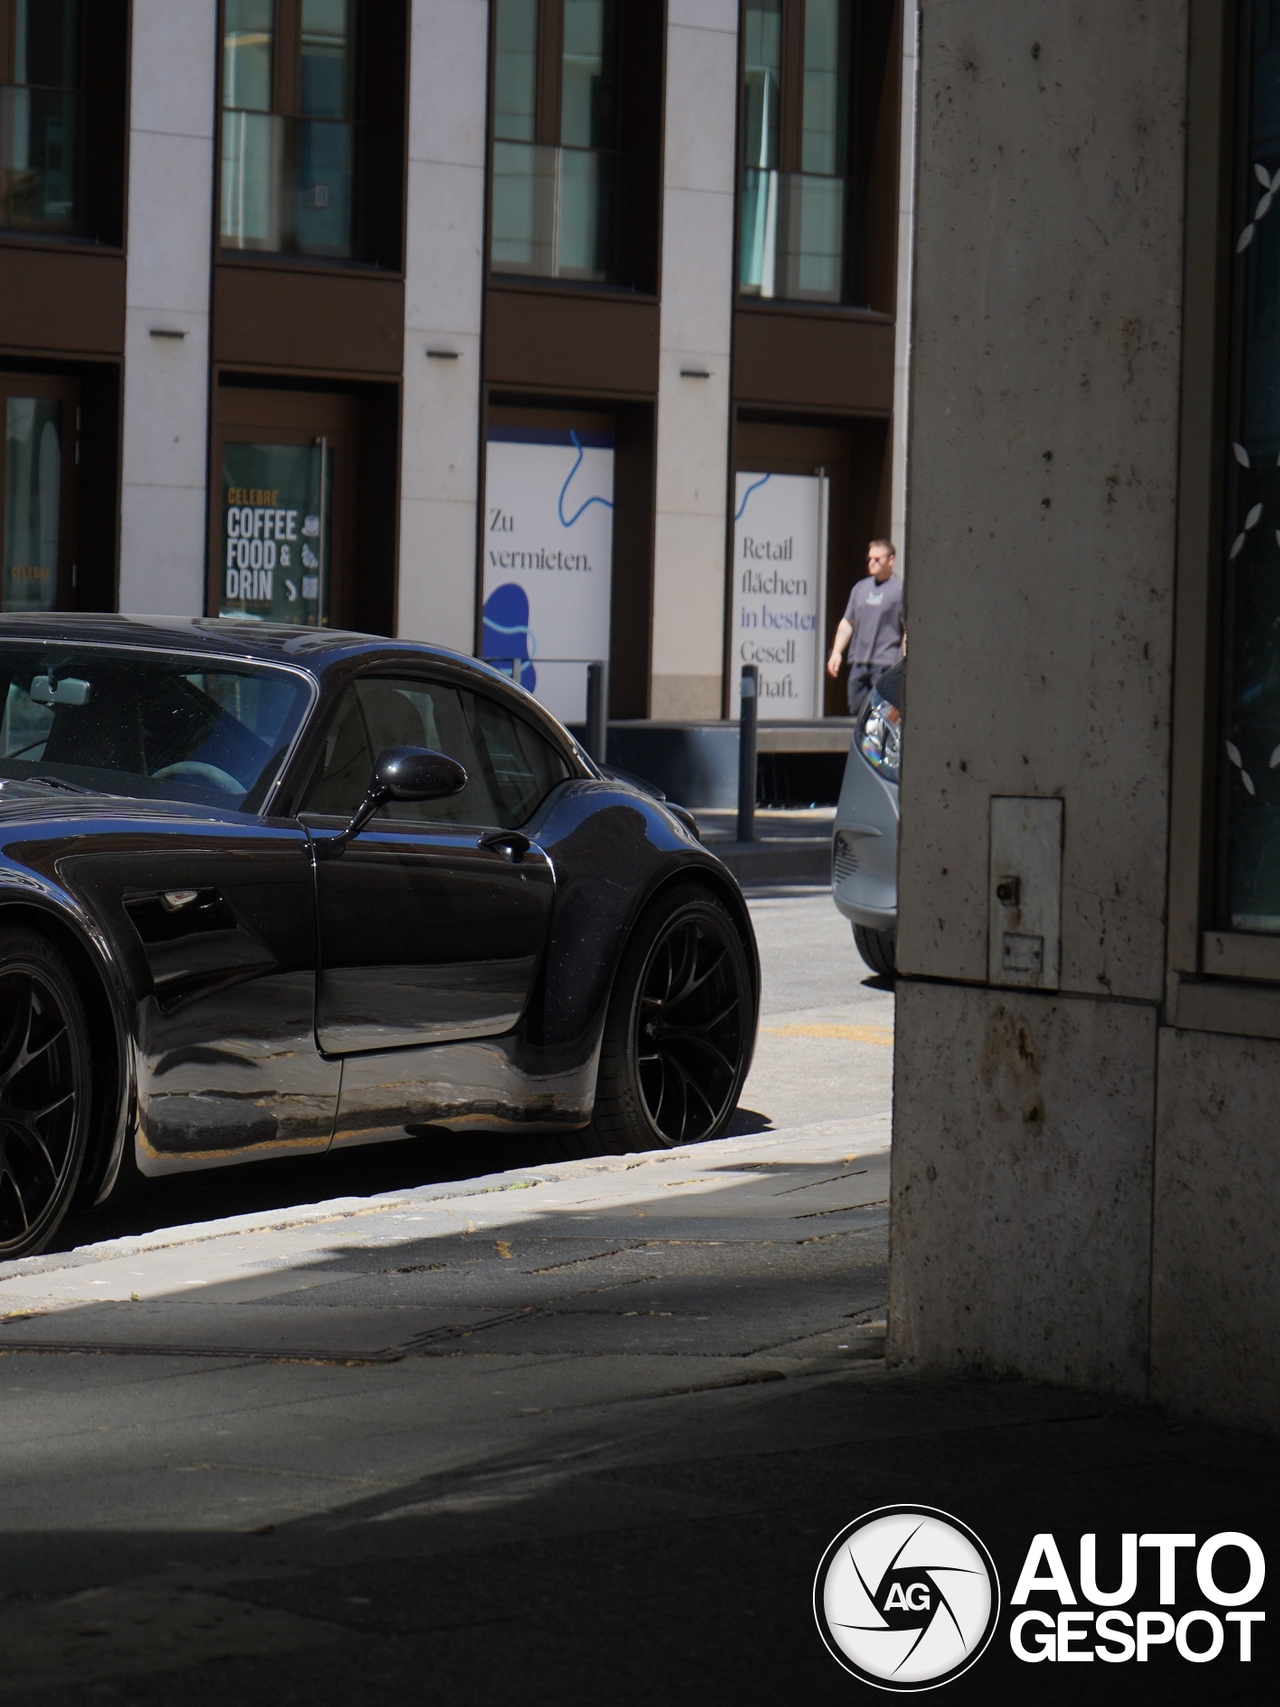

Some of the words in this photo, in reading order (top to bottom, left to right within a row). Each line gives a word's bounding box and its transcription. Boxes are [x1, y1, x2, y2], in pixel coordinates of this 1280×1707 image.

[228, 487, 279, 507] CELEBRE
[227, 506, 298, 541] COFFEE
[489, 508, 514, 532] Zu
[226, 538, 277, 570] FOOD
[280, 544, 291, 566] &
[489, 547, 592, 571] vermieten.
[226, 568, 273, 601] DRIN
[742, 568, 807, 596] flächen
[740, 606, 757, 628] in
[740, 672, 799, 698] haft.
